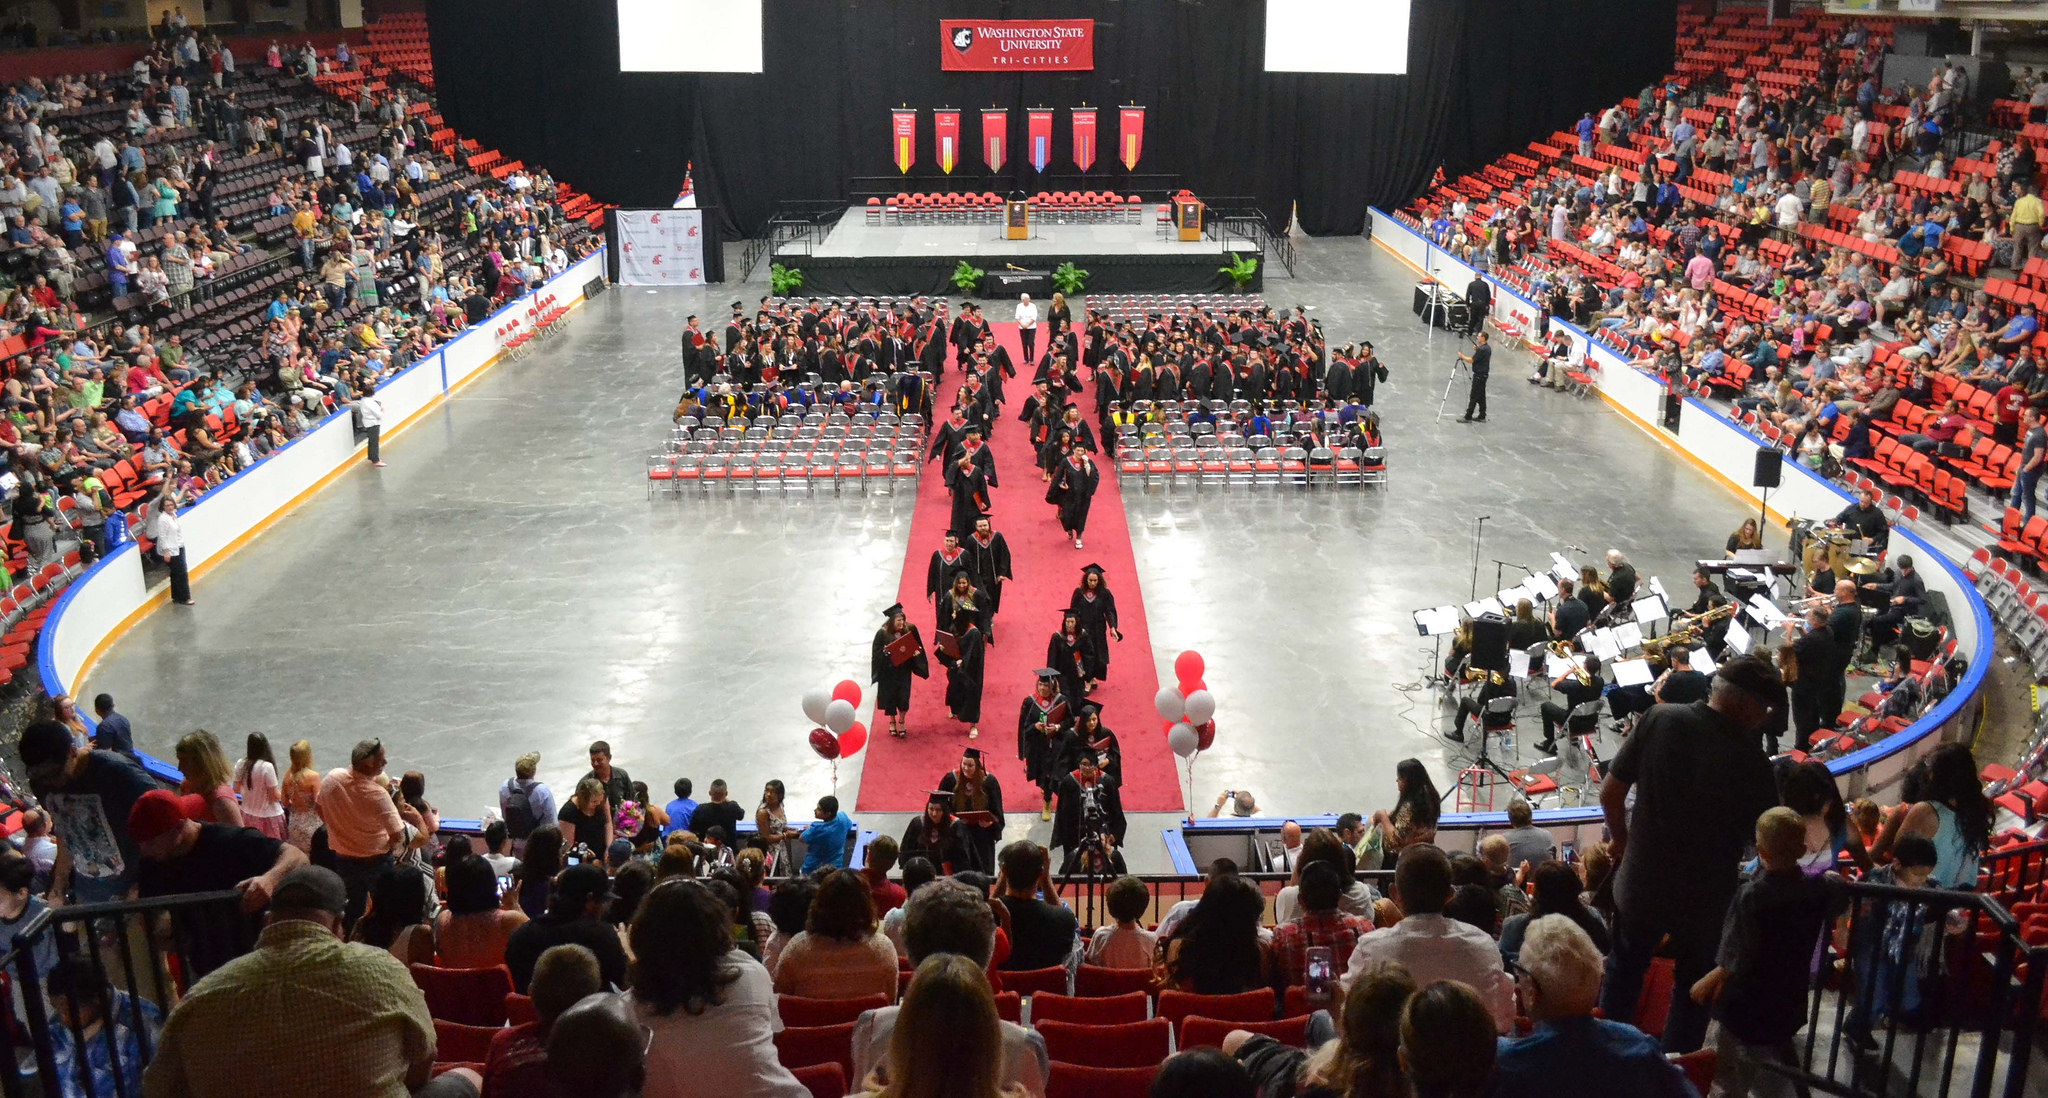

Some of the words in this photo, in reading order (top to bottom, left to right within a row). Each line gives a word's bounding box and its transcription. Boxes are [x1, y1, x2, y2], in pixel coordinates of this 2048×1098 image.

[977, 26, 1053, 39] WASHINGTON
[1053, 26, 1085, 38] STATE
[1000, 39, 1063, 52] UNIVERSITY
[992, 56, 1069, 65] TRI-CITIES
